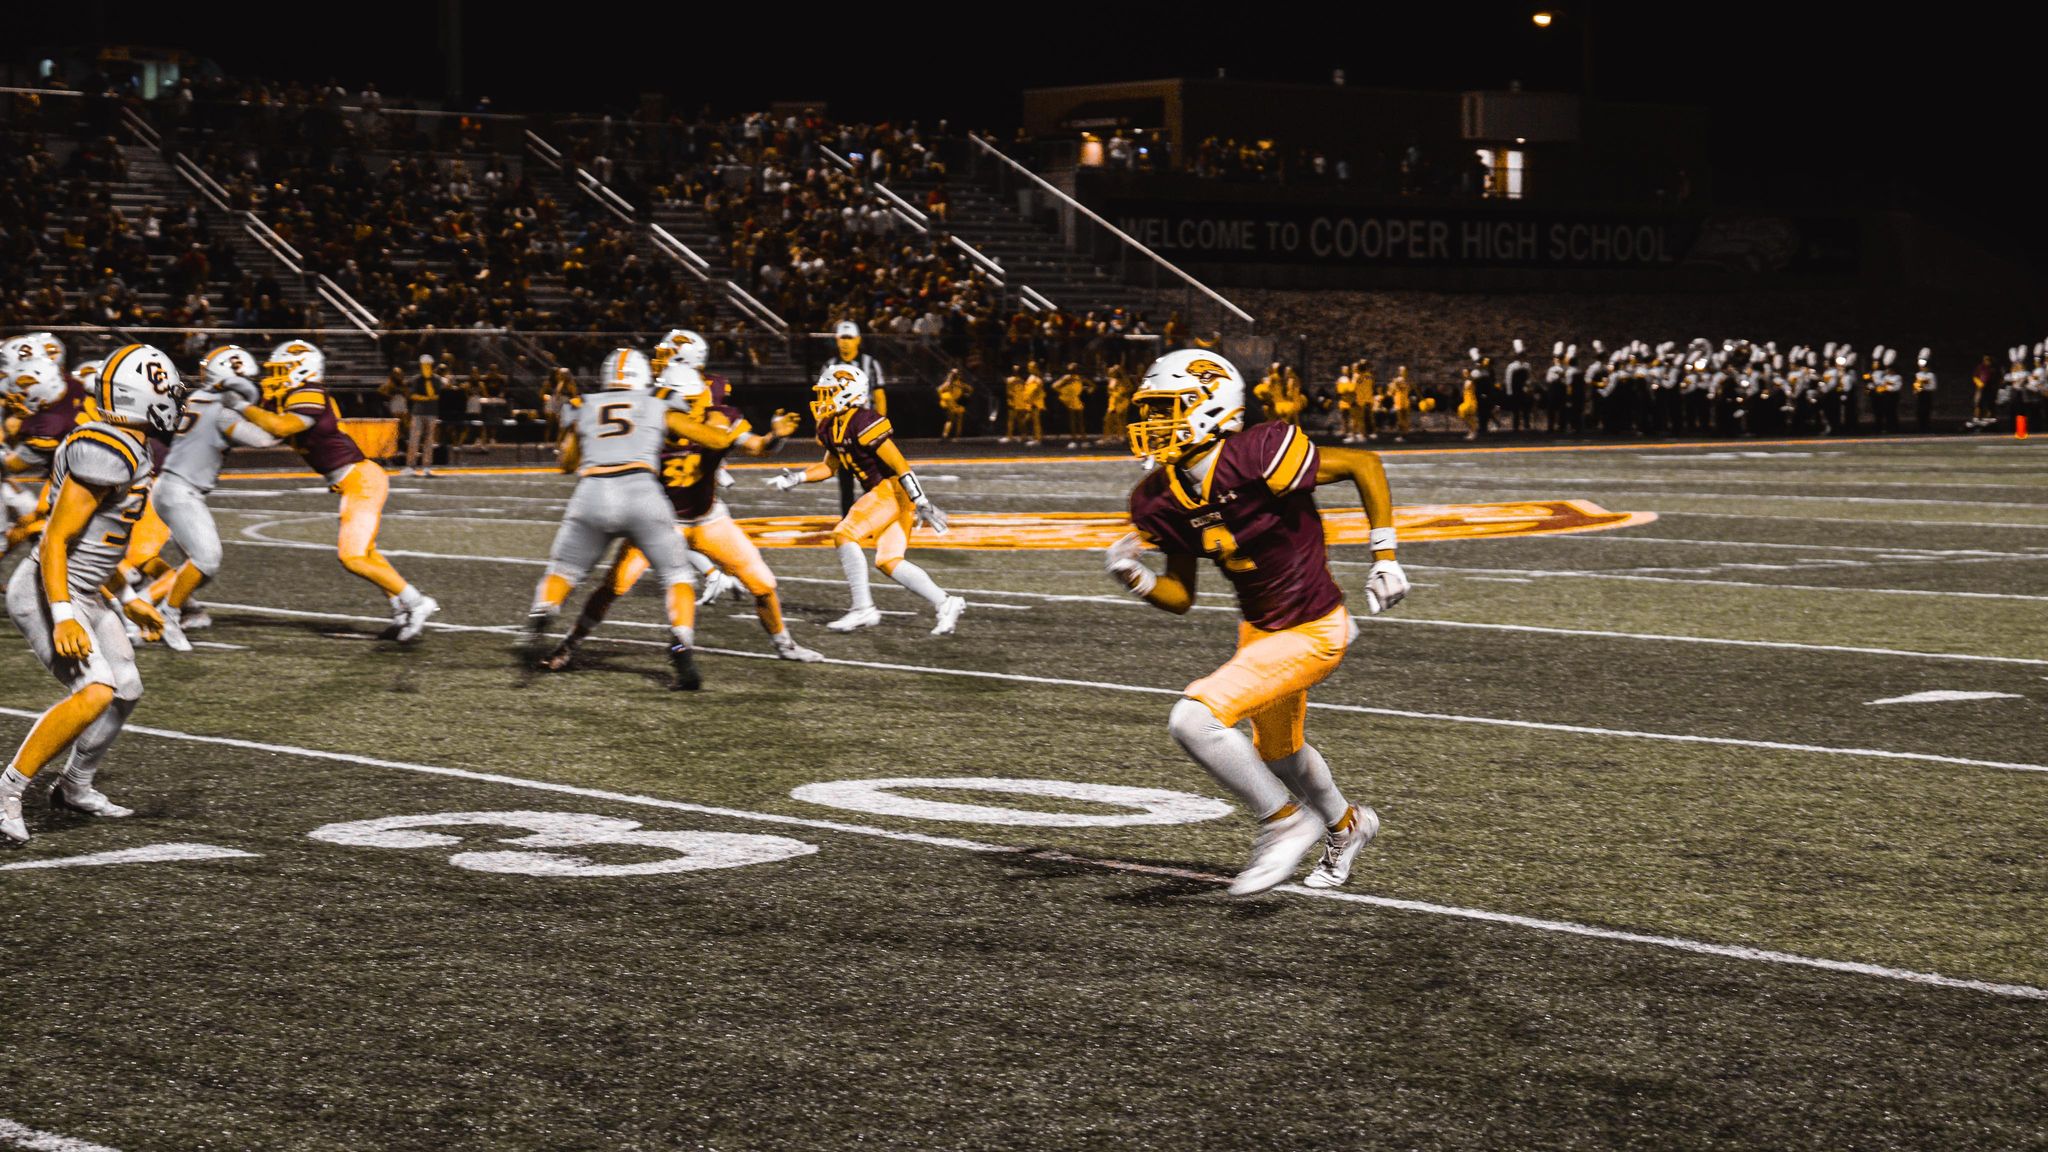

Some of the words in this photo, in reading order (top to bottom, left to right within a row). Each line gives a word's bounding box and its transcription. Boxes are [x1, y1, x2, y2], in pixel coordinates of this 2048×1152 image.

[1119, 216, 1258, 251] WELCOME
[1265, 219, 1300, 252] TO
[1310, 216, 1450, 258] COOPER
[1461, 221, 1537, 260] HIGH
[1549, 222, 1674, 262] SCHOOL
[596, 402, 635, 439] 5
[1201, 522, 1258, 573] 2
